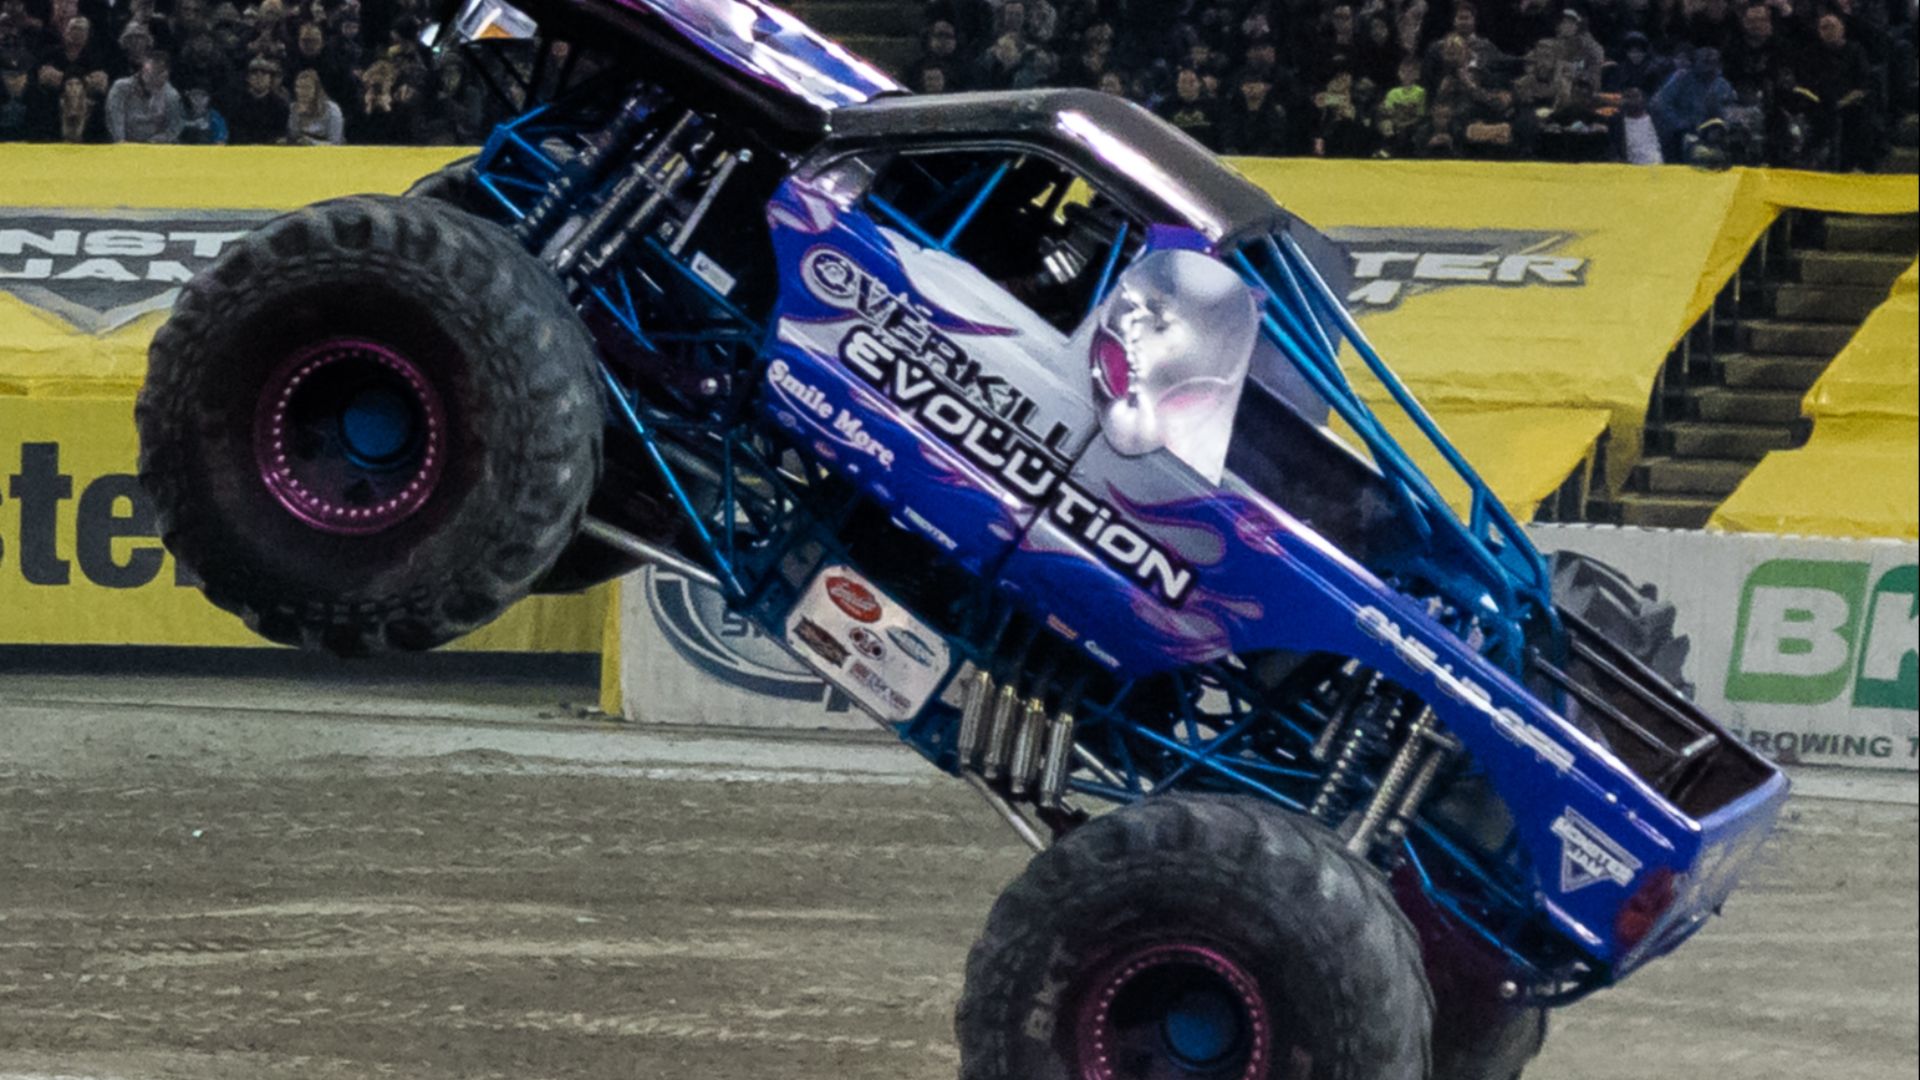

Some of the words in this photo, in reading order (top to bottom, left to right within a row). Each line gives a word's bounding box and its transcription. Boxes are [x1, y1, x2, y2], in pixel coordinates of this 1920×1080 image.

[806, 248, 1076, 468] OVERKILL
[768, 359, 834, 419] Smile
[1731, 730, 1893, 758] ROWING
